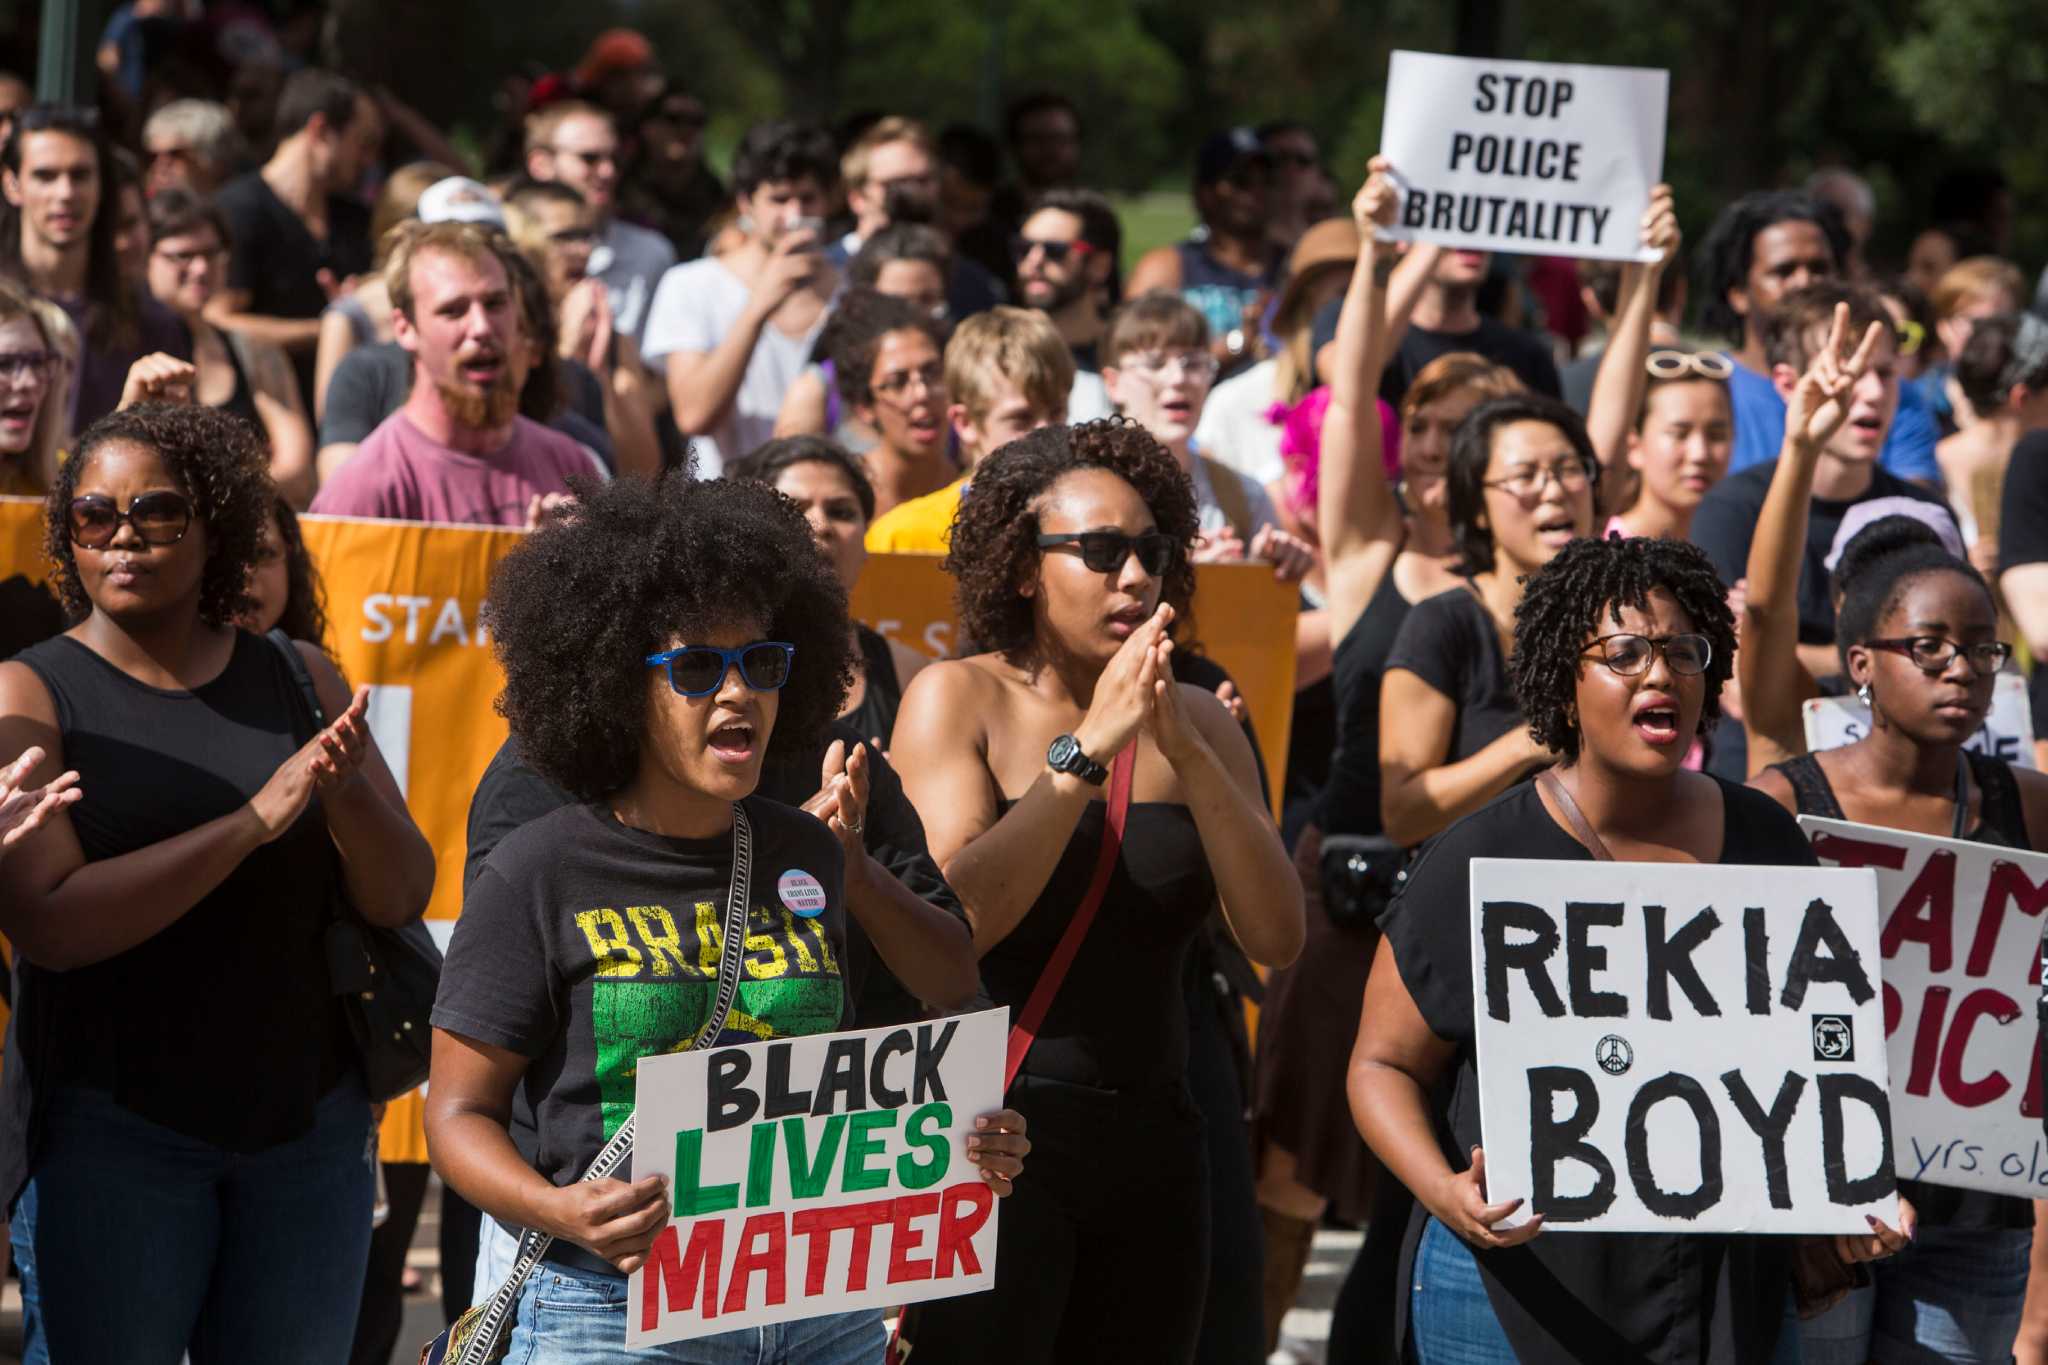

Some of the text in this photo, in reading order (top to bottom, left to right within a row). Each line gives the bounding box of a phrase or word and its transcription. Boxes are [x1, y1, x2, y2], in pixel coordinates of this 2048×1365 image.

[1475, 72, 1574, 119] STOP
[1449, 130, 1583, 182] POLICE
[1403, 187, 1612, 245] BRUTALITY
[1481, 897, 1876, 1023] REKIA
[706, 1020, 960, 1133] BLACK
[673, 1102, 954, 1218] LIVES
[1526, 1066, 1898, 1223] BOYD
[640, 1182, 994, 1332] MATTER
